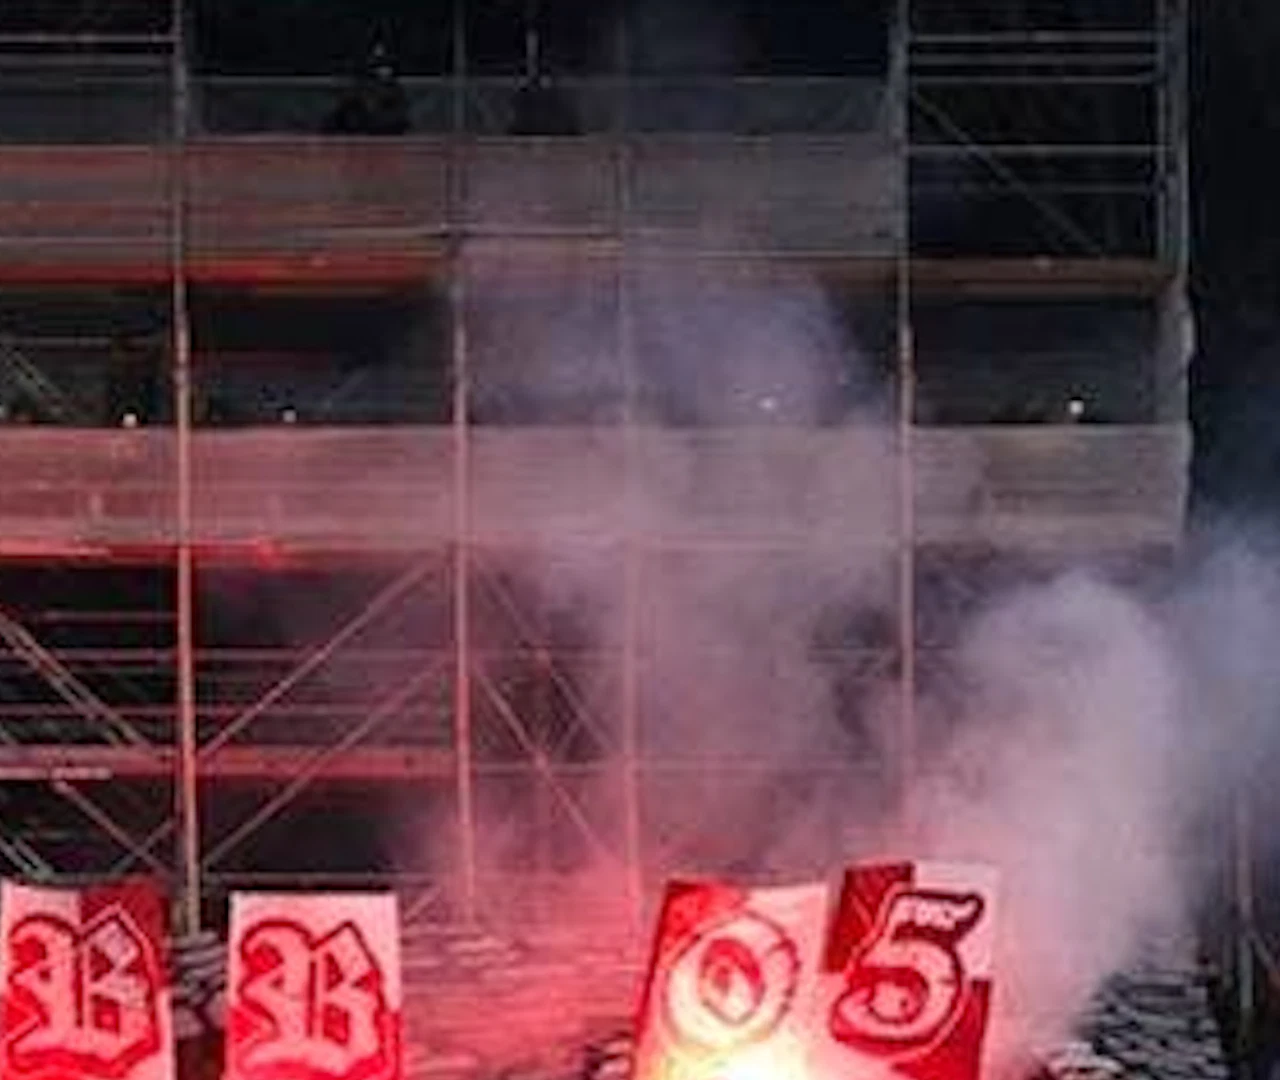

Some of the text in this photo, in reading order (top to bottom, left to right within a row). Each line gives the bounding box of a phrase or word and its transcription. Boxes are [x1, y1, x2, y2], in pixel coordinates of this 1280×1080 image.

[9, 914, 157, 1070] B
[240, 919, 384, 1080] B
[830, 889, 984, 1050] 5
